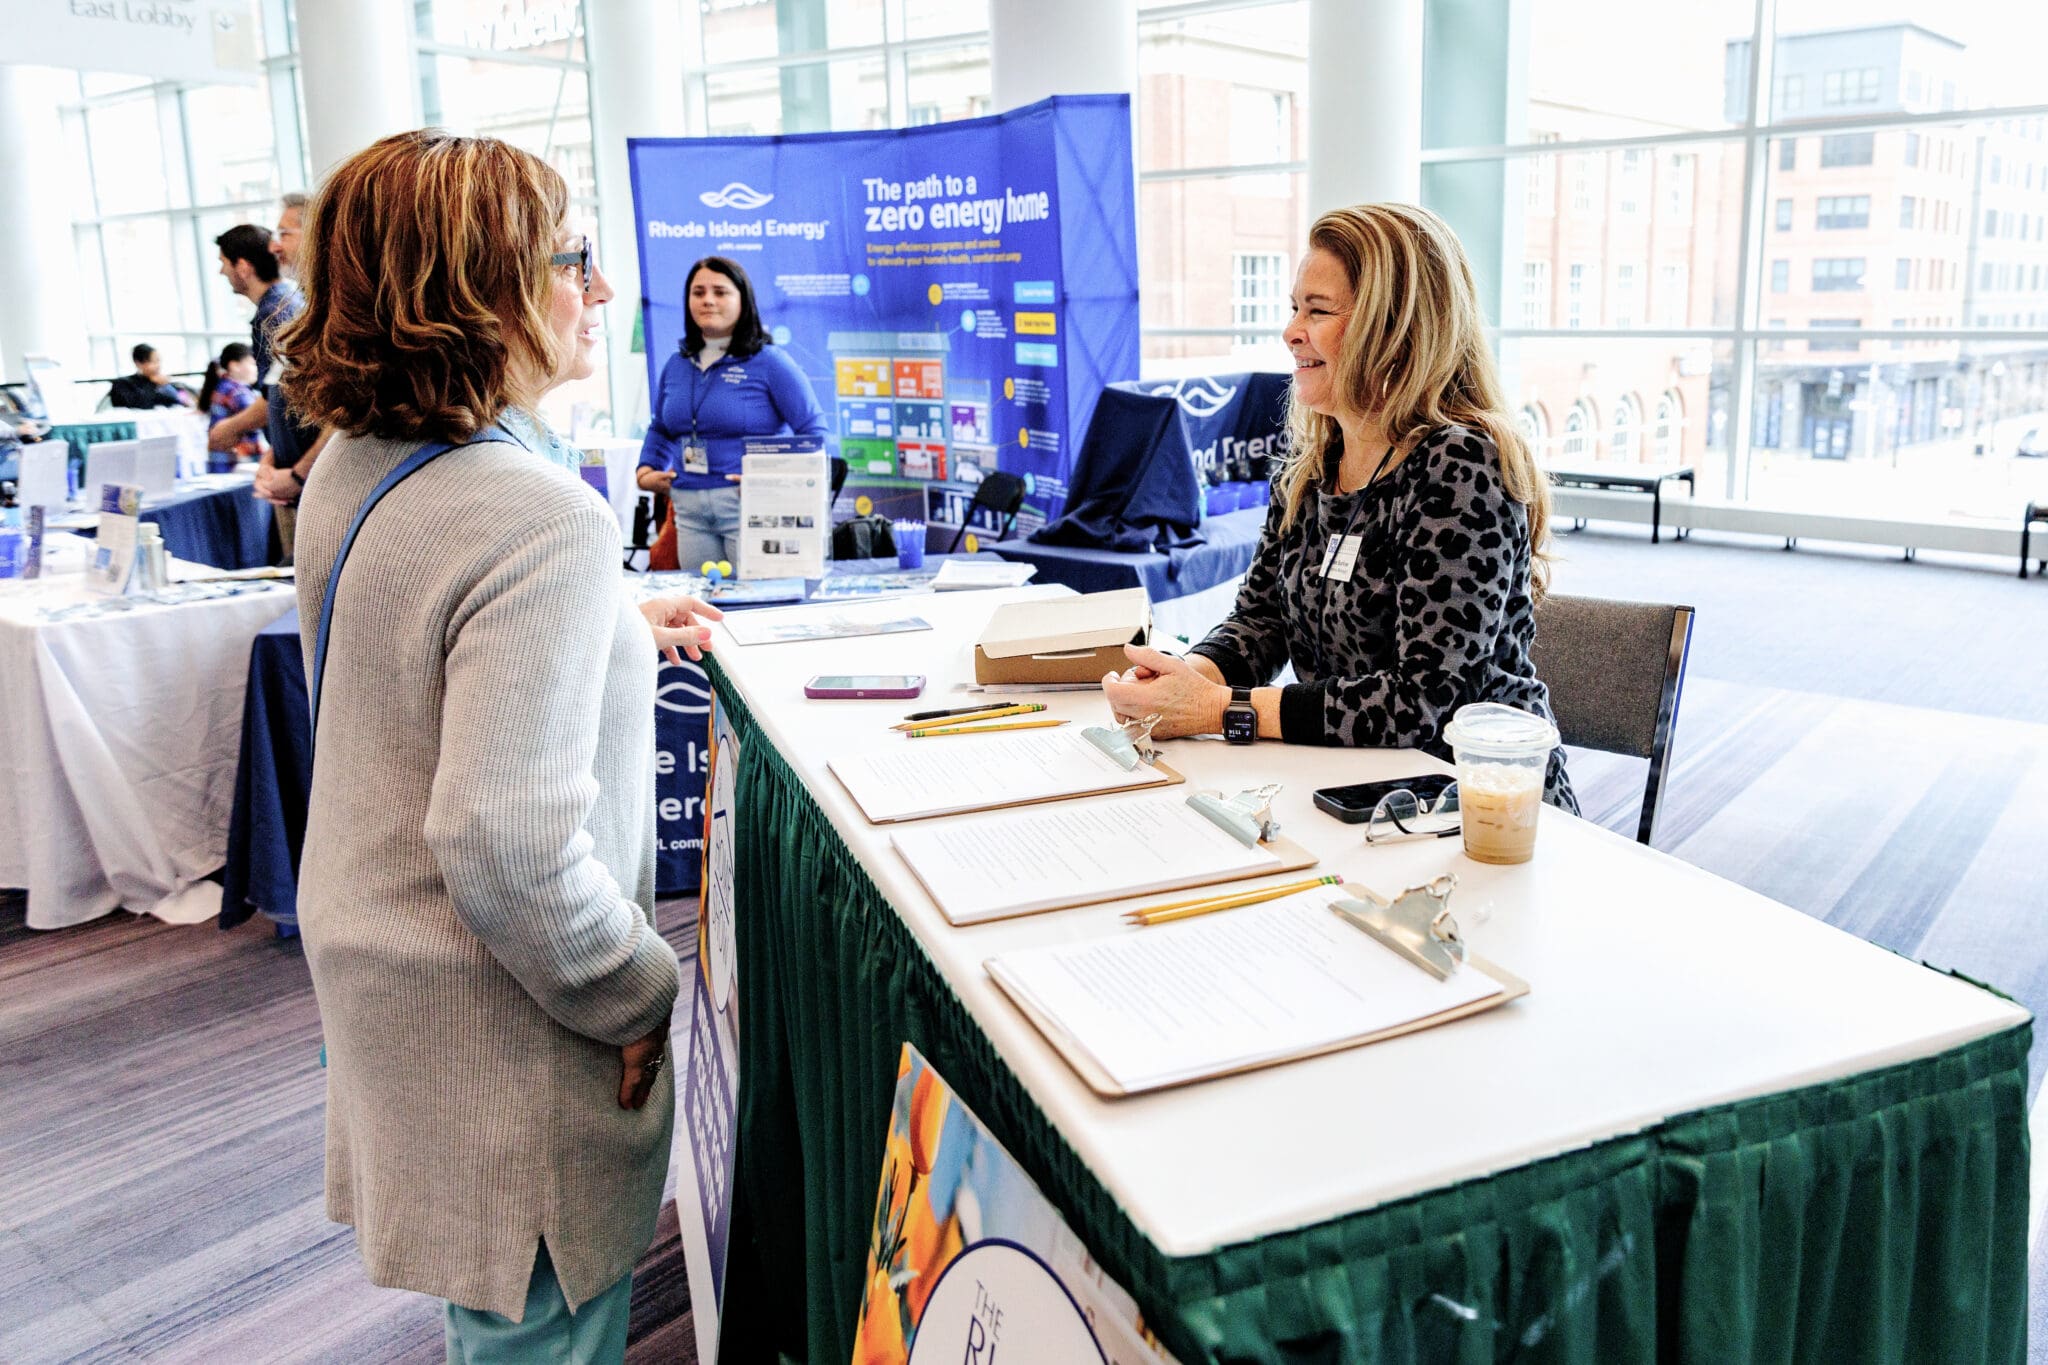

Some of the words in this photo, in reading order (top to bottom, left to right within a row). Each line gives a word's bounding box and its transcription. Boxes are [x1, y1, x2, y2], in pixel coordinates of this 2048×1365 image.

[125, 0, 196, 38] Lobby
[863, 177, 902, 202] The
[904, 173, 943, 205] path
[945, 174, 963, 197] to
[966, 175, 978, 195] a
[864, 204, 925, 232] zero
[929, 198, 1004, 234] energy
[1006, 187, 1049, 224] home
[648, 220, 706, 238] Rhode
[708, 219, 763, 238] Island
[659, 796, 706, 821] er
[975, 1279, 1004, 1342] THE
